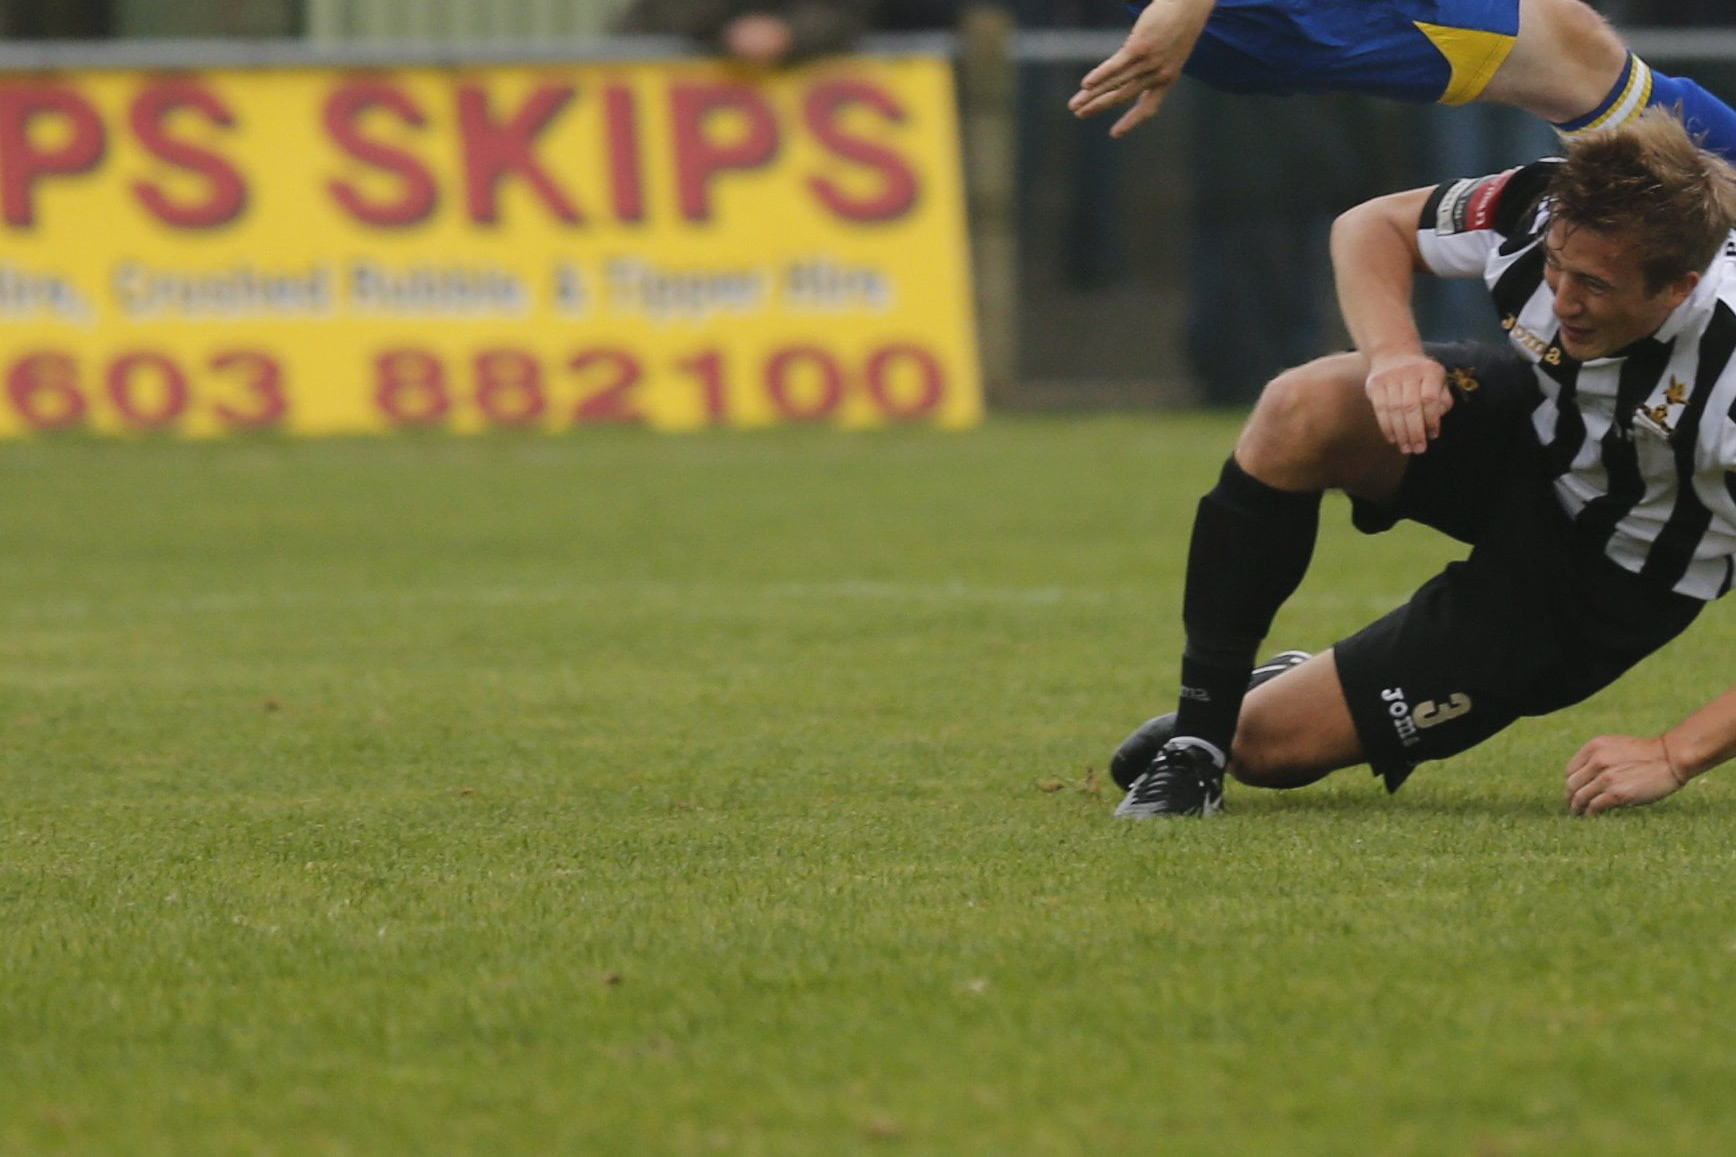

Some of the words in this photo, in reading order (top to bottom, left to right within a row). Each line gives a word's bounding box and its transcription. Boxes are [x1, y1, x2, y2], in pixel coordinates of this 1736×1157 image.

[321, 75, 920, 230] SKIPS
[7, 348, 287, 430] 603
[373, 342, 946, 426] 882100
[1412, 692, 1473, 730] 3
